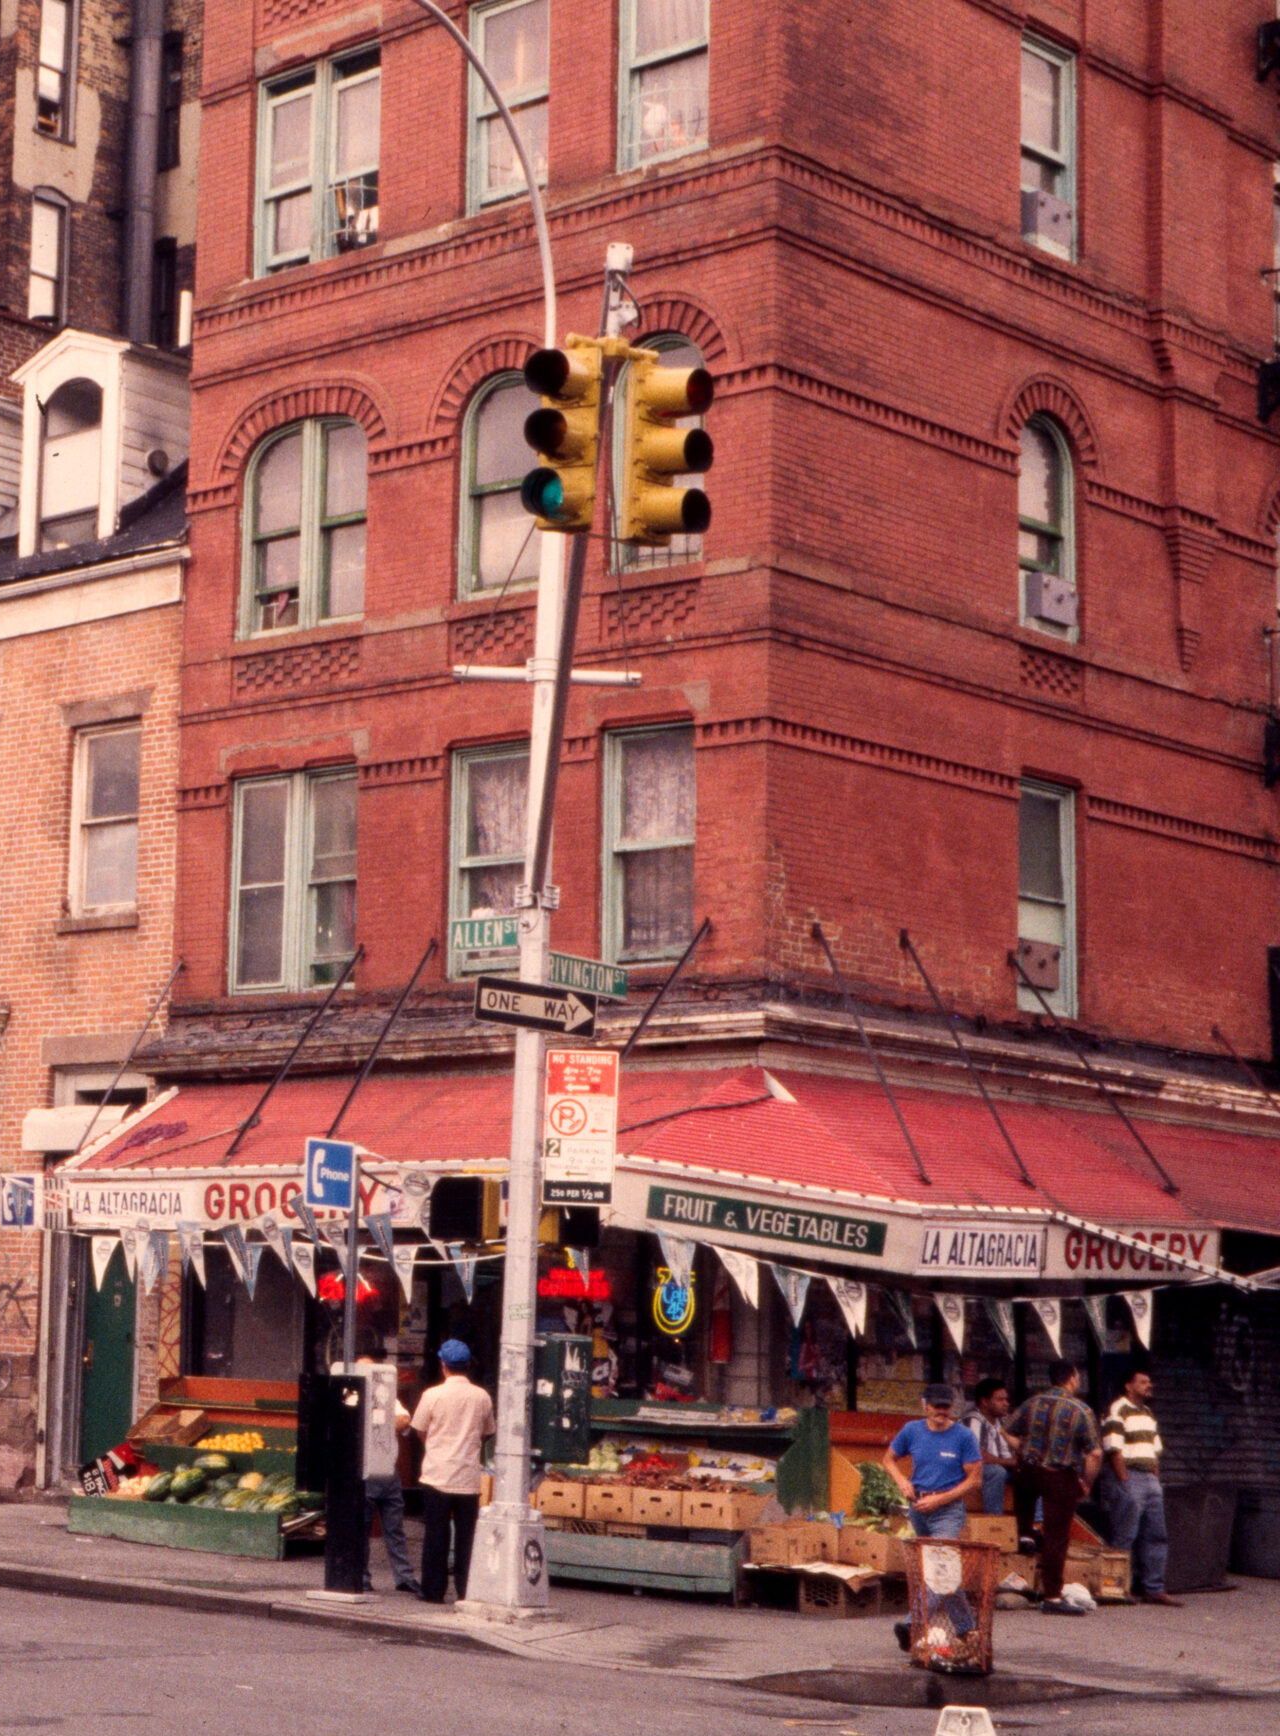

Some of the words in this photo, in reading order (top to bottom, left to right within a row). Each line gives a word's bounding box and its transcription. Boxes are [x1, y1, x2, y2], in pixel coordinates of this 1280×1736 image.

[453, 921, 503, 948] ALLEN
[505, 919, 518, 933] ST
[549, 954, 614, 993] RIVINGTON
[614, 970, 625, 983] ST
[487, 992, 520, 1012] ONE
[545, 1001, 578, 1021] WAY
[552, 1054, 565, 1064] NO
[569, 1054, 613, 1066] STANDING
[320, 1167, 349, 1182] Phone
[76, 1191, 91, 1214] LA
[99, 1191, 182, 1215] ALTAGRACIA
[205, 1182, 380, 1220] GROCY
[566, 1189, 580, 1198] PER
[663, 1194, 717, 1223] FRUIT
[724, 1211, 738, 1229] &
[746, 1207, 869, 1248] VEGETABLES
[922, 1231, 941, 1264] LA
[947, 1231, 1037, 1267] ALTAGRACIA
[1064, 1229, 1209, 1271] GROCERY
